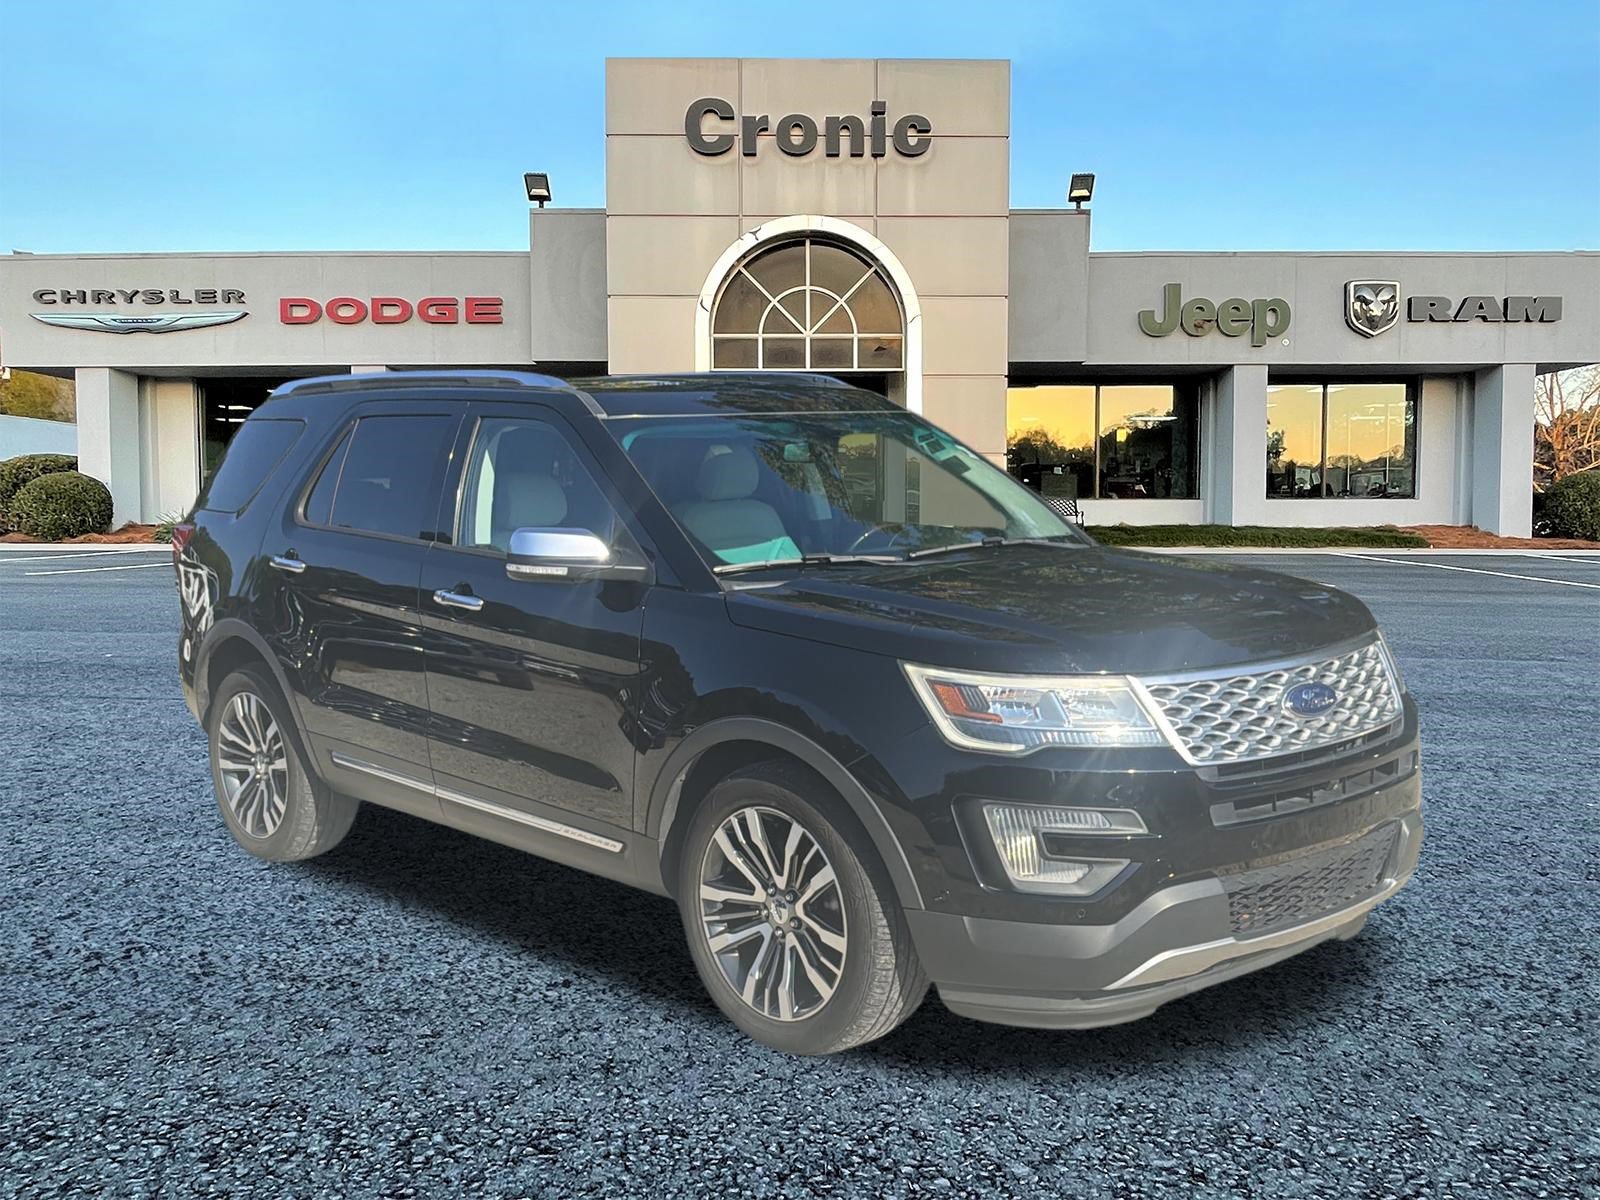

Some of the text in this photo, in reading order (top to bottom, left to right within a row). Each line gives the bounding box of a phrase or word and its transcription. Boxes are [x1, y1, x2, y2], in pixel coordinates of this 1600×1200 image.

[685, 97, 932, 157] Cronic
[32, 289, 246, 304] CHRYSLER
[1408, 296, 1563, 323] RAM
[279, 297, 503, 325] DODGE
[1138, 283, 1291, 347] Jeep
